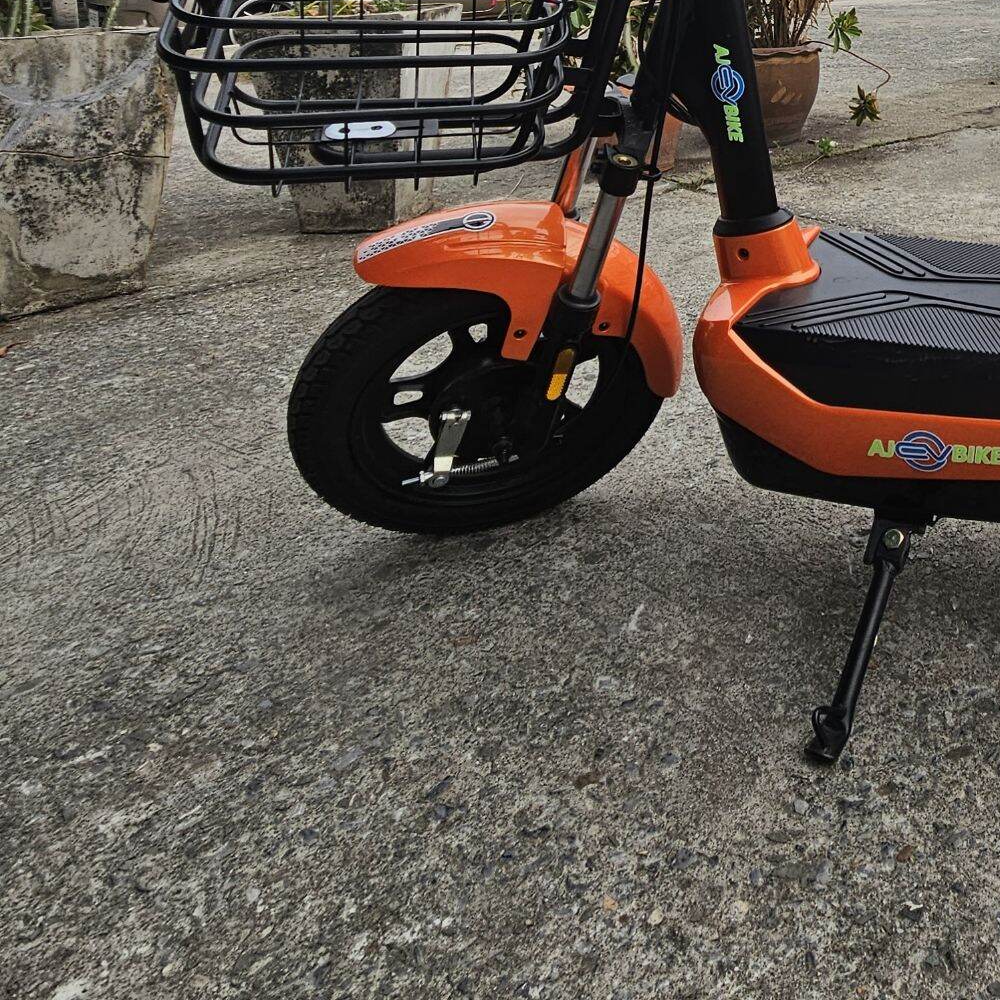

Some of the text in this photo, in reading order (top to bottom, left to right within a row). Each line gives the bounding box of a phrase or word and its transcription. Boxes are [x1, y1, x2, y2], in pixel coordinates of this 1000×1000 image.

[714, 44, 731, 65] AJ
[723, 104, 744, 142] BIKE
[867, 439, 896, 458] AJ
